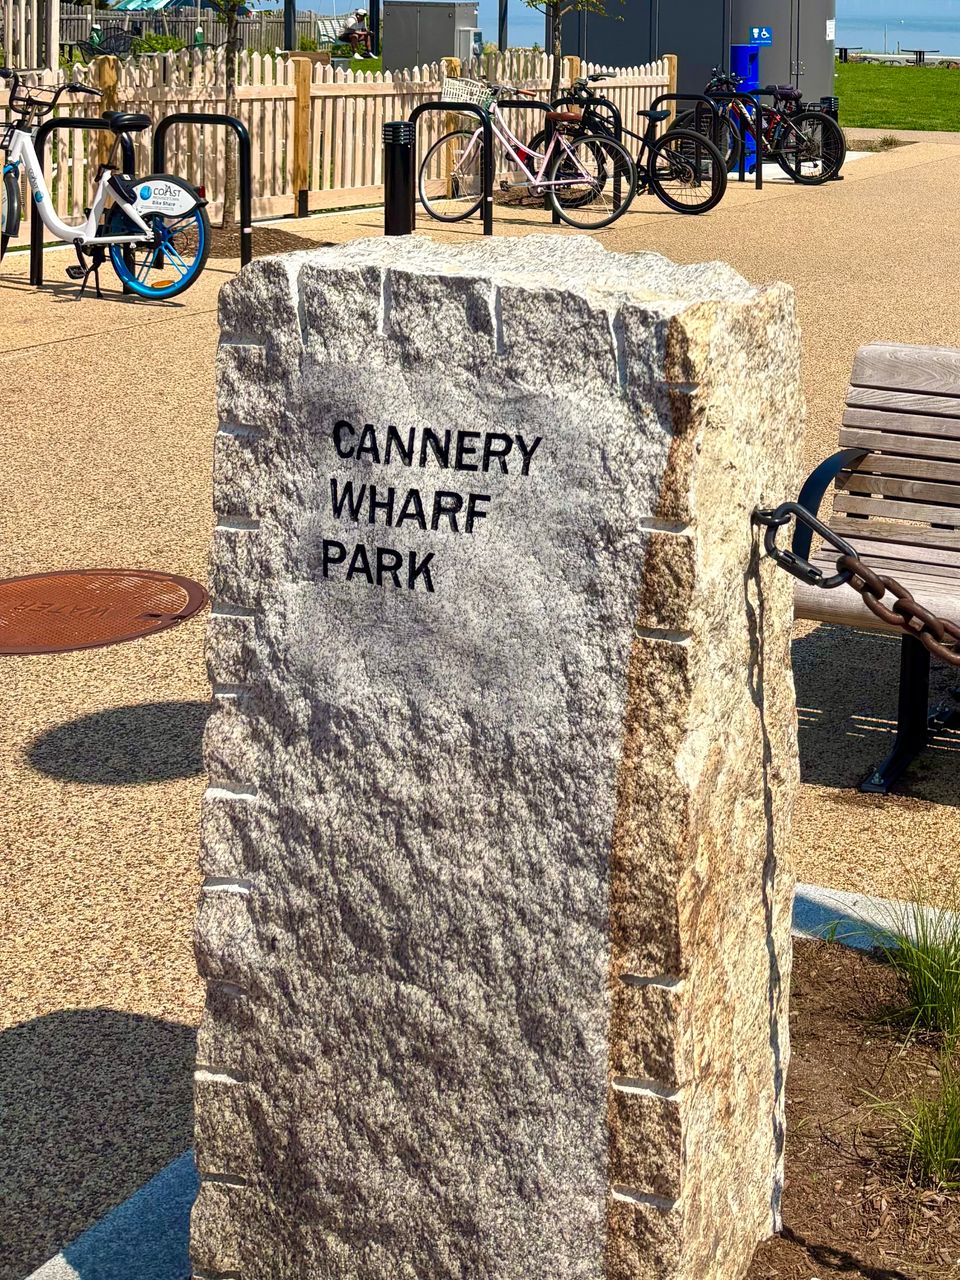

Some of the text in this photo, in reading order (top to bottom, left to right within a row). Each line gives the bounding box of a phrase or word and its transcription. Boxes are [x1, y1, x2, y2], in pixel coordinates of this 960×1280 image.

[153, 186, 181, 197] COAST
[332, 419, 543, 476] CANNERY
[329, 477, 491, 534] WHARF
[322, 539, 435, 593] PARK
[14, 601, 110, 617] WATER
